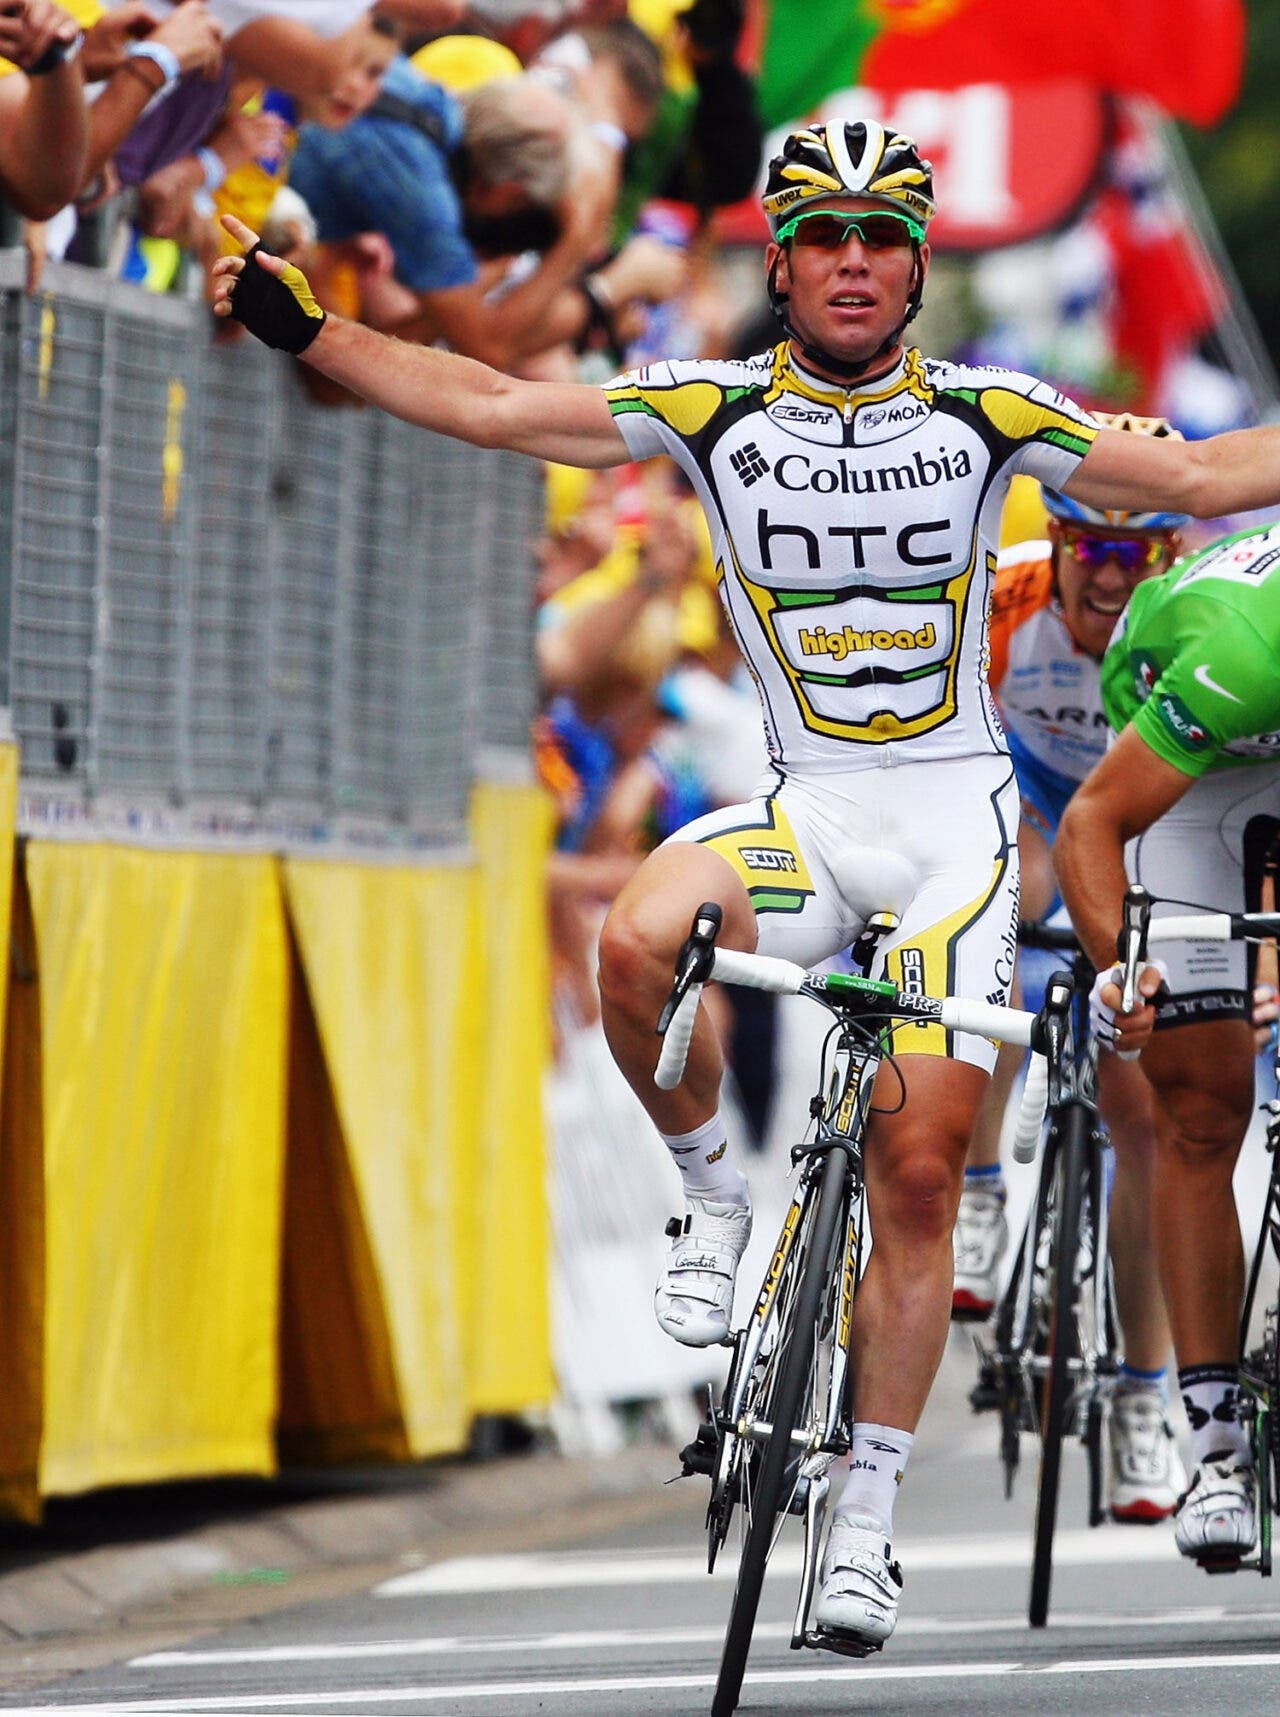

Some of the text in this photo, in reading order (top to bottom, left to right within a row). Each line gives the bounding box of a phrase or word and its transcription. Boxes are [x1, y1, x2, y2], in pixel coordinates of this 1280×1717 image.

[775, 187, 801, 206] uvex
[771, 405, 833, 425] SCOTT
[888, 404, 926, 423] MOA
[774, 445, 972, 495] Columbia
[800, 623, 936, 661] highroad
[741, 847, 797, 872] SCOTT
[901, 948, 926, 1000] SCO
[836, 1060, 861, 1134] SCOTT
[757, 1203, 800, 1327] SCOTT
[838, 1217, 858, 1349] SCOTT
